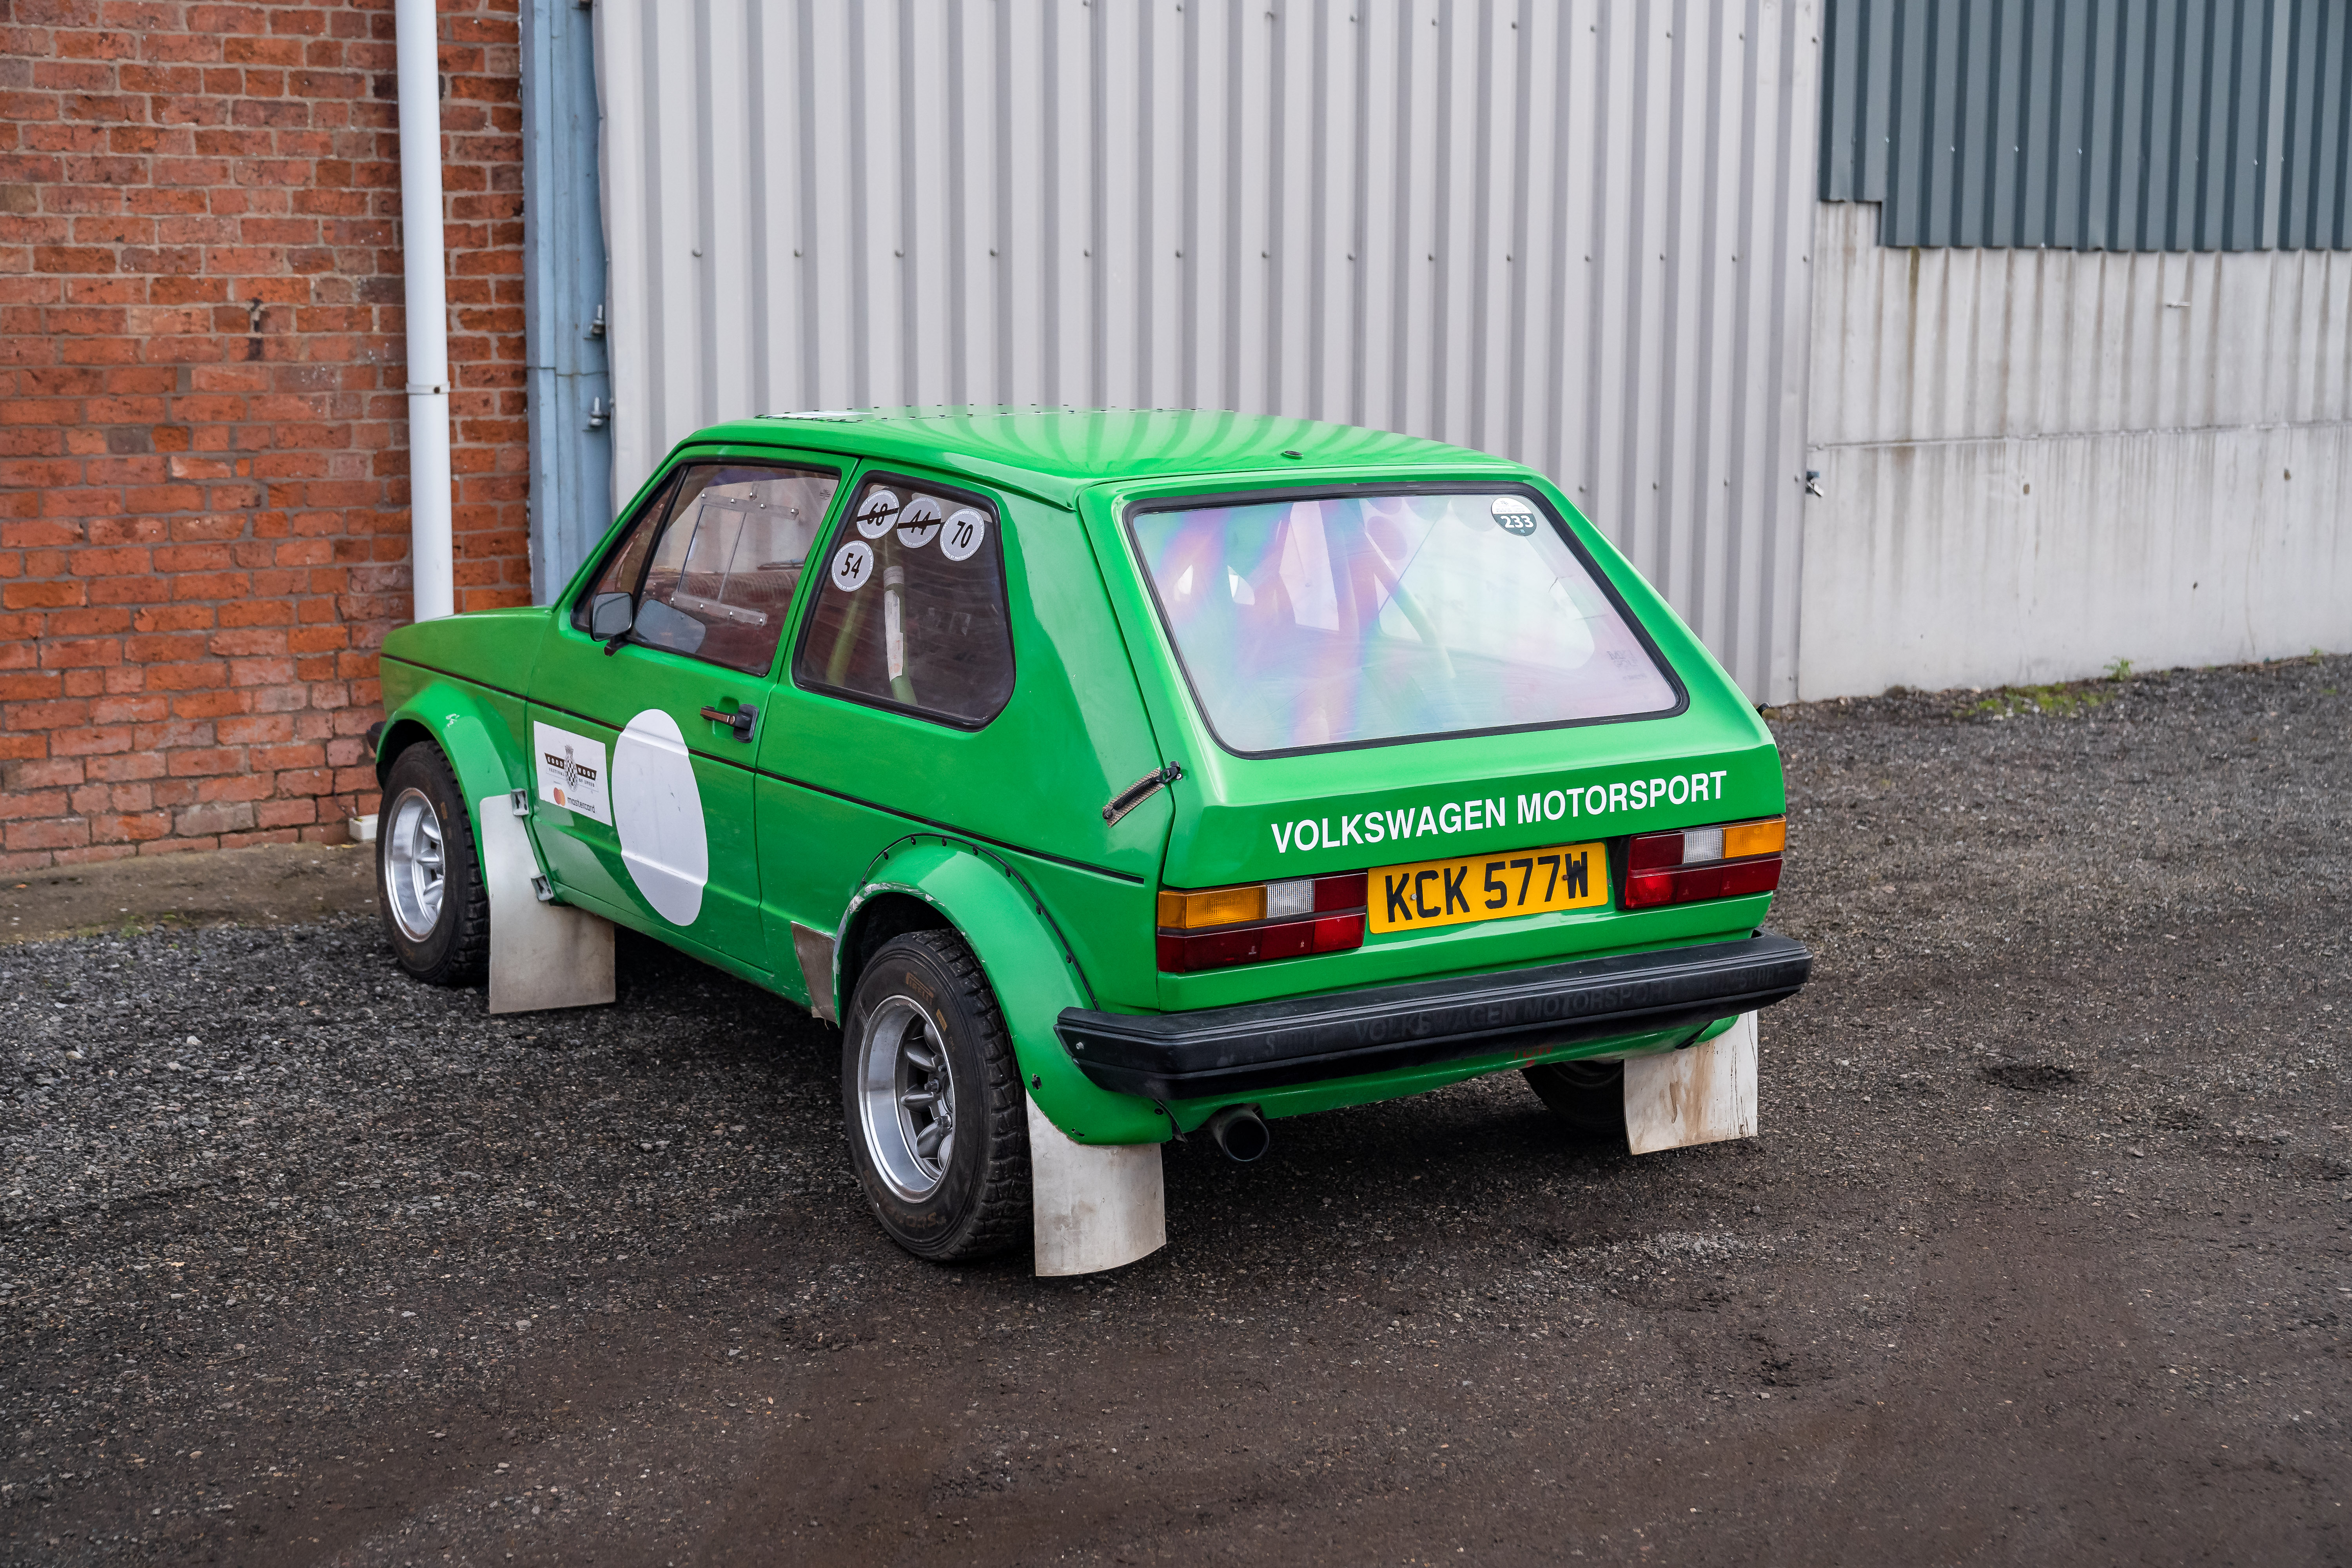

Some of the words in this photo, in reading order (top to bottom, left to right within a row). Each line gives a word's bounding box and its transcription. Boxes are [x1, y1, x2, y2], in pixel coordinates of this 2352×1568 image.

[950, 511, 969, 520] GOODWOOD
[970, 511, 980, 521] FESTIVAL
[1500, 515, 1534, 528] 233
[913, 535, 932, 546] MASTERCARD
[951, 521, 973, 548] 70
[840, 542, 858, 552] GOODWOOD
[858, 542, 869, 552] FESTIVAL
[941, 541, 951, 557] PRESENTED
[955, 550, 974, 560] MASTERCARD
[841, 552, 863, 579] 54
[847, 580, 865, 590] MASTERCARD
[568, 797, 595, 813] mastercard
[1271, 797, 1506, 853] VOLKSWAGEN
[1517, 770, 1727, 824] MOTORSPORT
[1385, 866, 1470, 923] KCK
[1484, 851, 1588, 909] 577W
[906, 972, 934, 1006] PIRELLI
[1524, 981, 1676, 1019] MOTORSPORT
